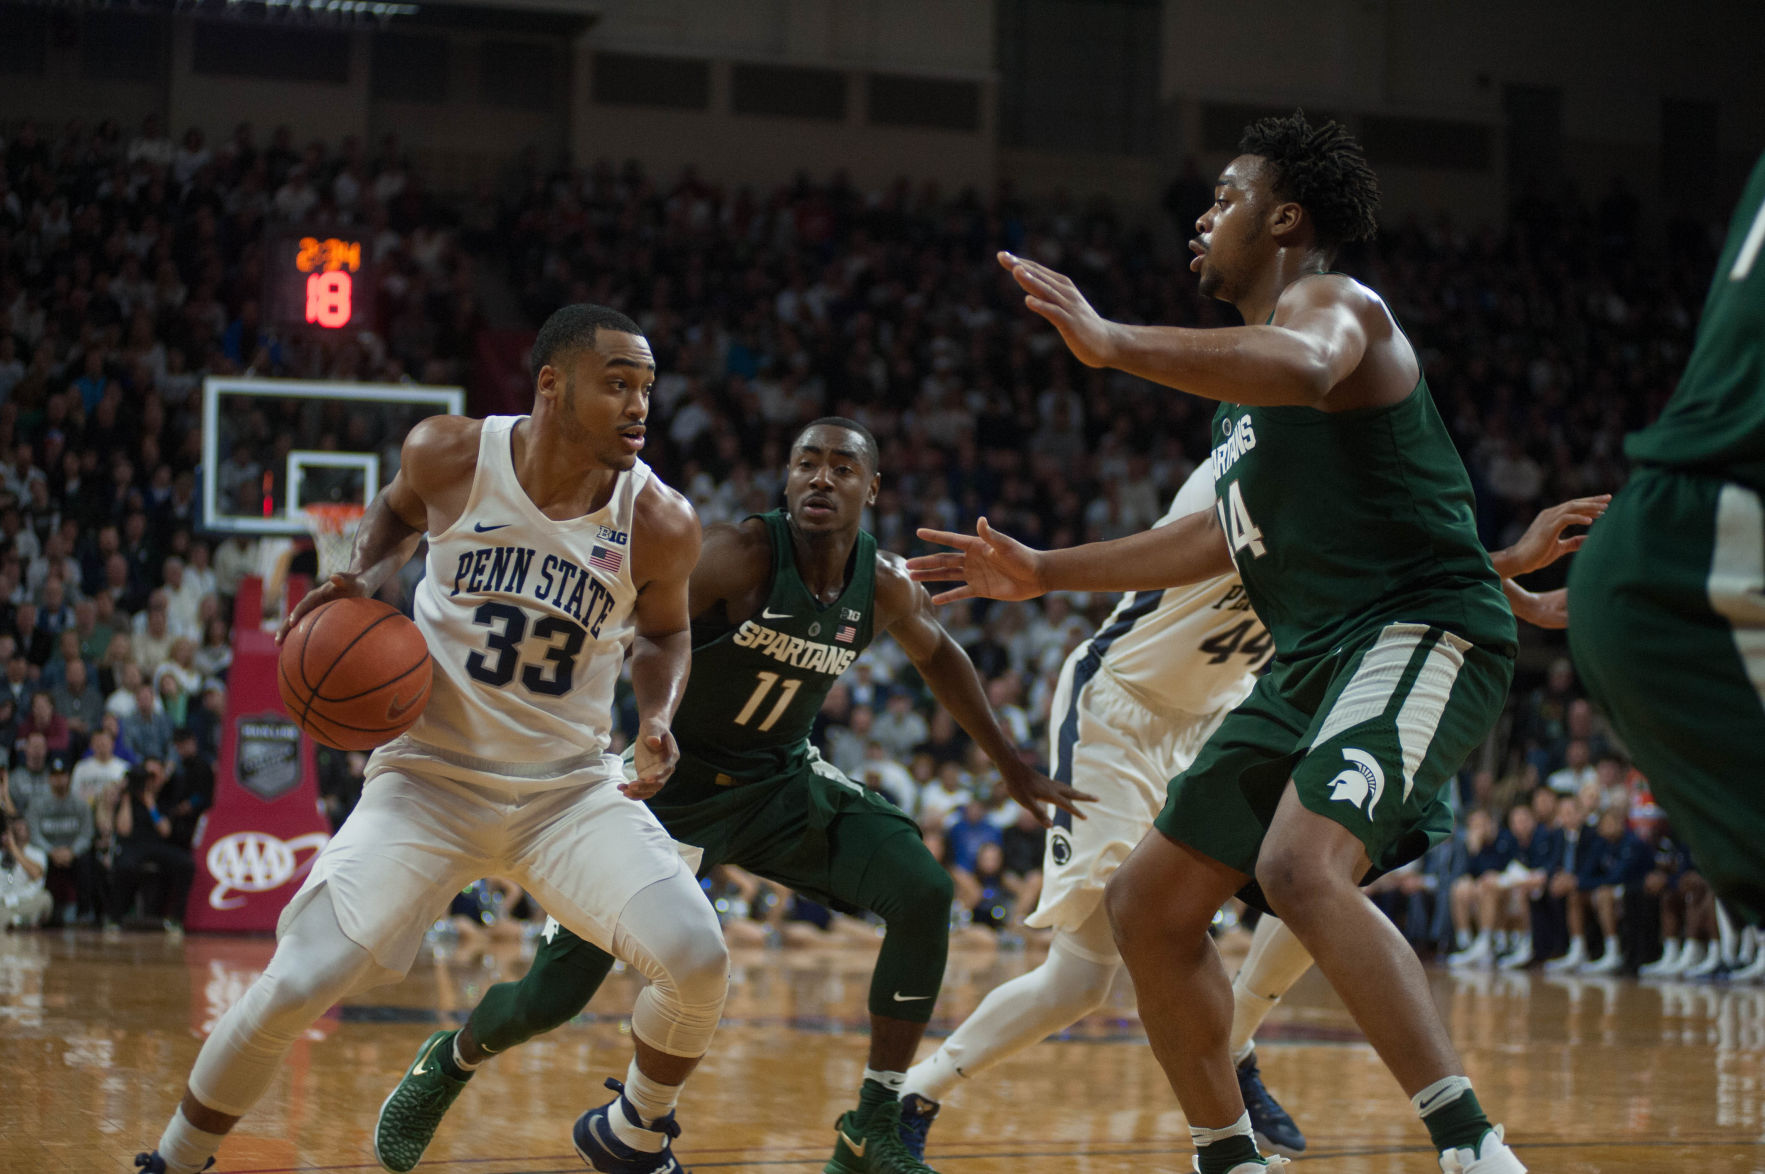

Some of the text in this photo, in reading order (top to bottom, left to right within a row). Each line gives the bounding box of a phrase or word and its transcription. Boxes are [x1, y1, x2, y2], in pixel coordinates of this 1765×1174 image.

[306, 270, 352, 328] 18
[1211, 413, 1256, 481] ARTANS
[450, 546, 616, 640] PENN STATE
[1212, 585, 1251, 610] PE
[465, 601, 588, 698] 33
[732, 619, 856, 675] SPARTANS
[1198, 619, 1274, 665] 44
[733, 671, 803, 731] 11
[213, 836, 288, 888] AAA
